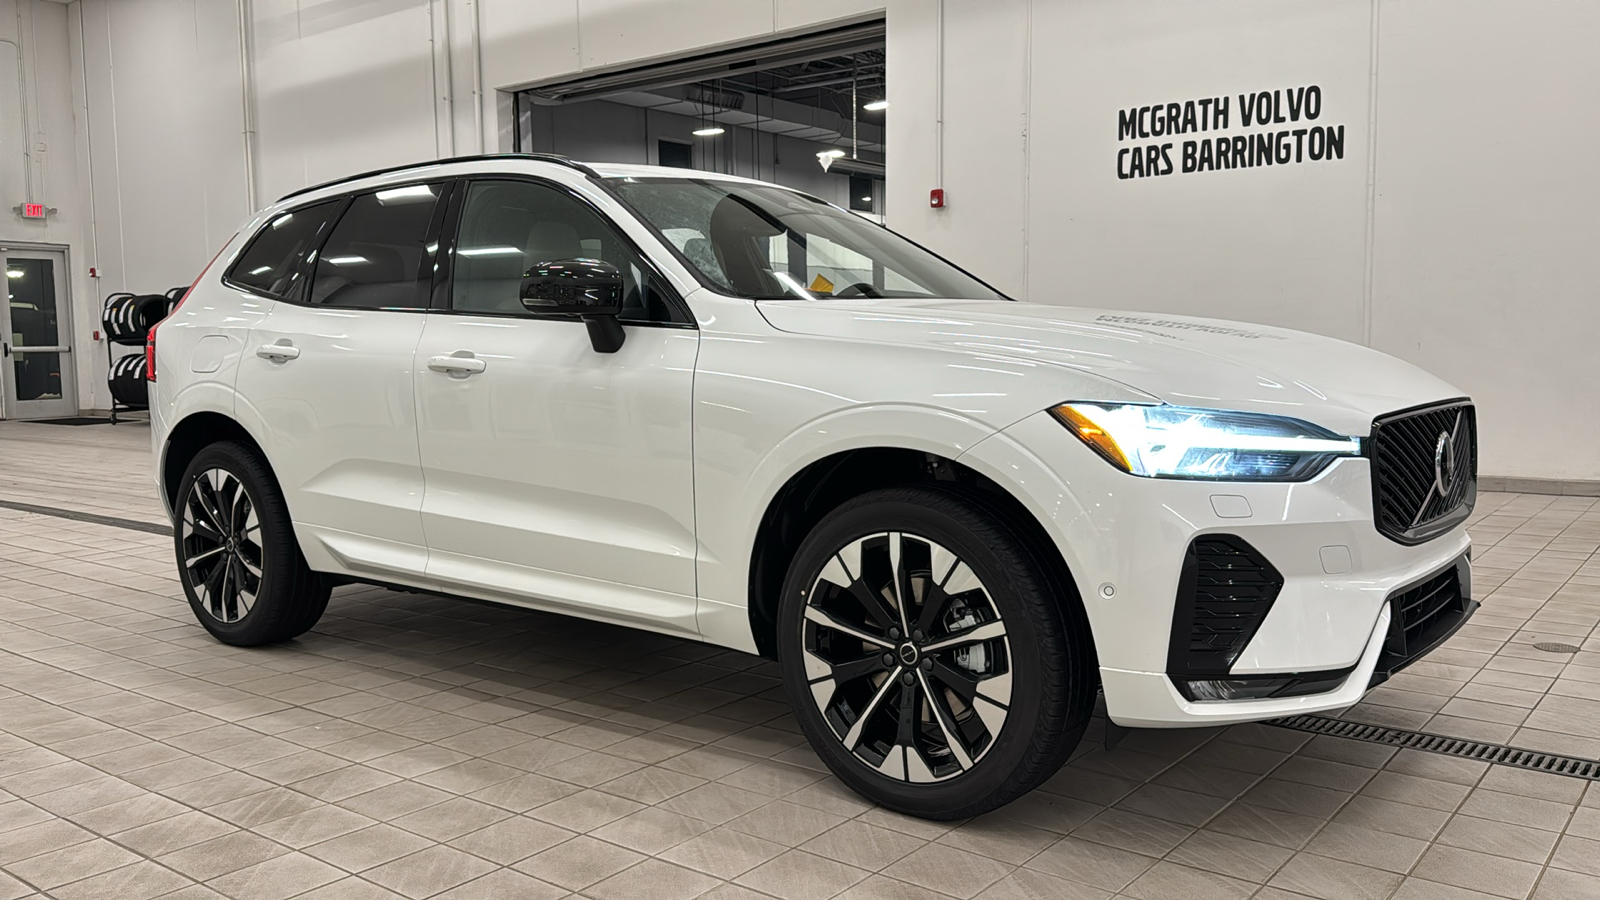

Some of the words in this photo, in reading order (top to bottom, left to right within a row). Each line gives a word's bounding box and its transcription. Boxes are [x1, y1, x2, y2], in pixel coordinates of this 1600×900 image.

[1118, 96, 1230, 142] MCGRATH
[1238, 85, 1322, 127] VOLVO
[1117, 142, 1174, 180] CARS
[1181, 124, 1345, 174] BARRINGTON
[26, 203, 43, 217] EXIT
